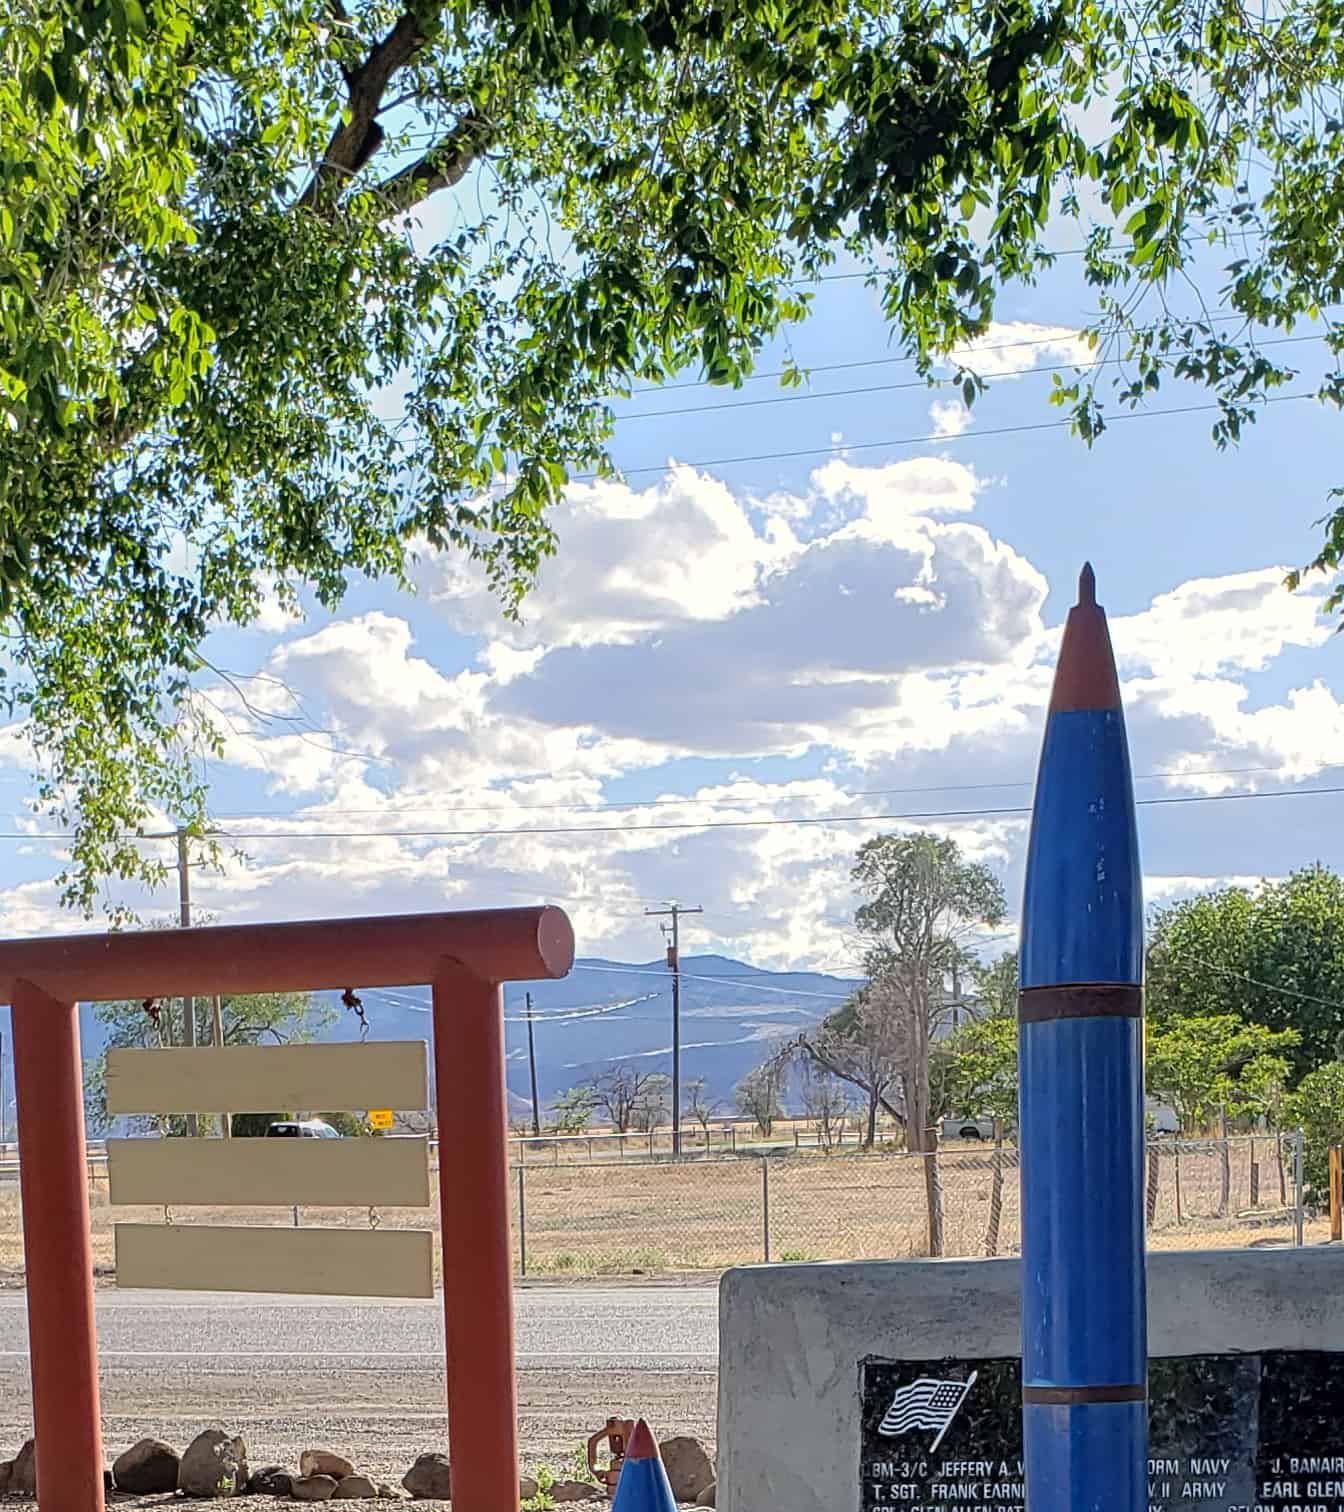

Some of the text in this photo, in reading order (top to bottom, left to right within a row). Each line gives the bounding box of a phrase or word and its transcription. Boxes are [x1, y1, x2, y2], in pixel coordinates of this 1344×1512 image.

[872, 1462, 928, 1478] BM-3/C
[938, 1461, 993, 1477] JEFFERY
[1147, 1459, 1178, 1475] ORM
[1190, 1458, 1230, 1475] NAVY
[1271, 1458, 1285, 1474] J.
[872, 1484, 886, 1500] T.
[890, 1484, 920, 1499] SGT.
[931, 1483, 978, 1499] FRANK
[1161, 1482, 1171, 1498] II
[1182, 1482, 1226, 1498] ARMY
[1263, 1482, 1302, 1498] EARL
[1307, 1481, 1344, 1498] GLEN
